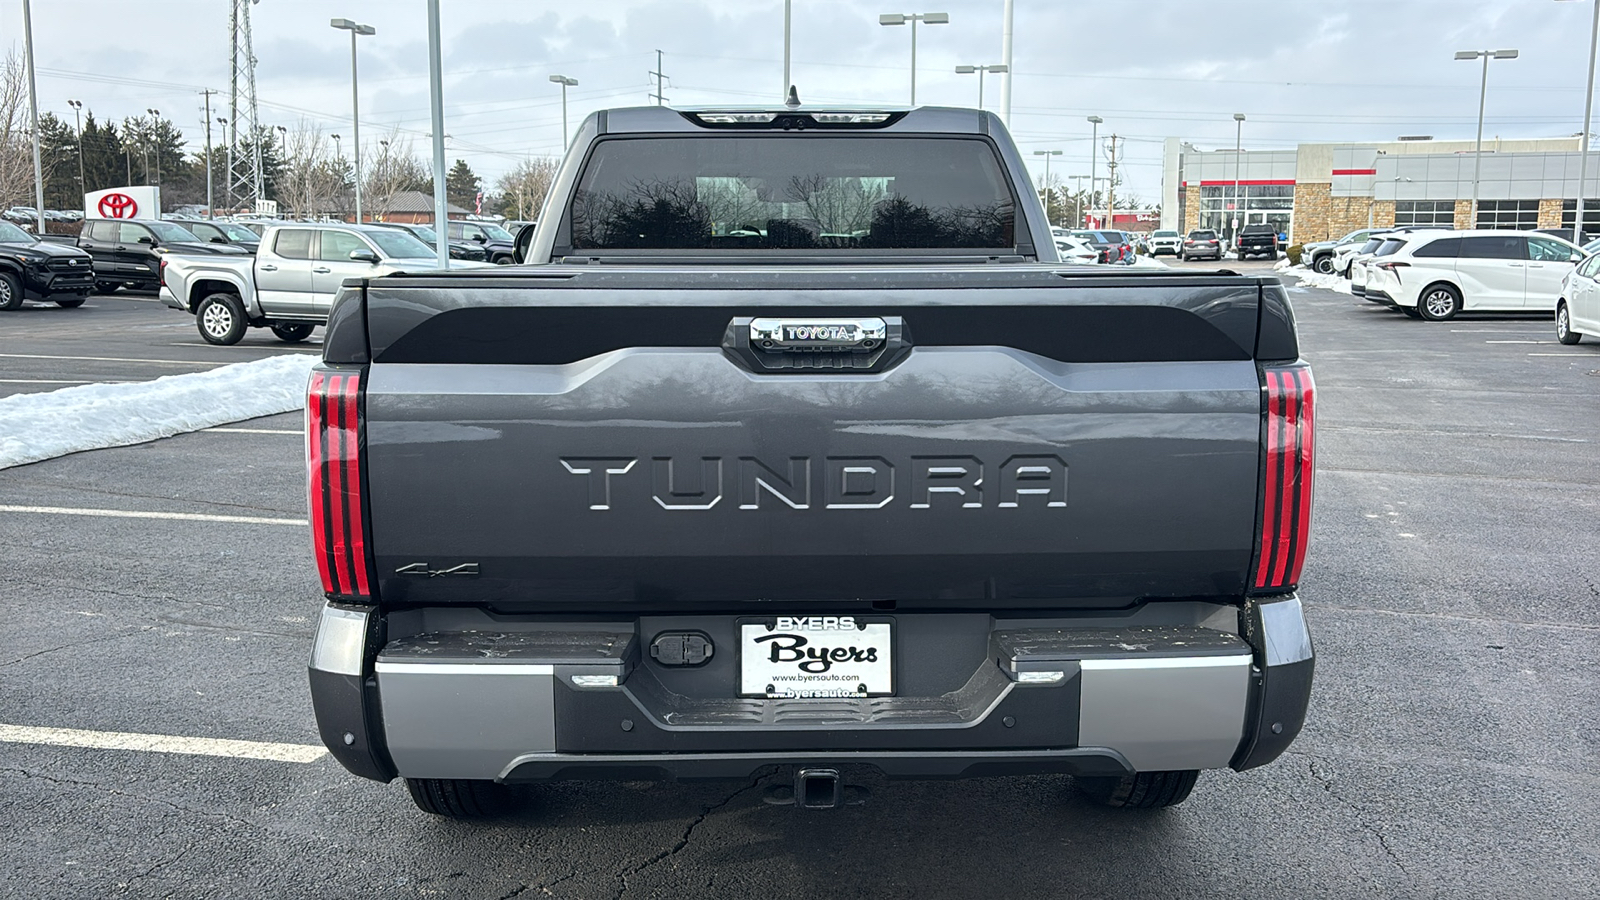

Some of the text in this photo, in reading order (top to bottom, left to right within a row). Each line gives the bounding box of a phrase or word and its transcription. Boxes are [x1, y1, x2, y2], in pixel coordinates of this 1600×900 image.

[786, 327, 850, 340] TOYOTA
[559, 455, 1069, 511] TUNDRA
[776, 616, 856, 632] BYERS
[753, 633, 879, 674] Byers
[772, 673, 860, 683] www.byersauto.com
[766, 688, 868, 700] www.byersauto.com
